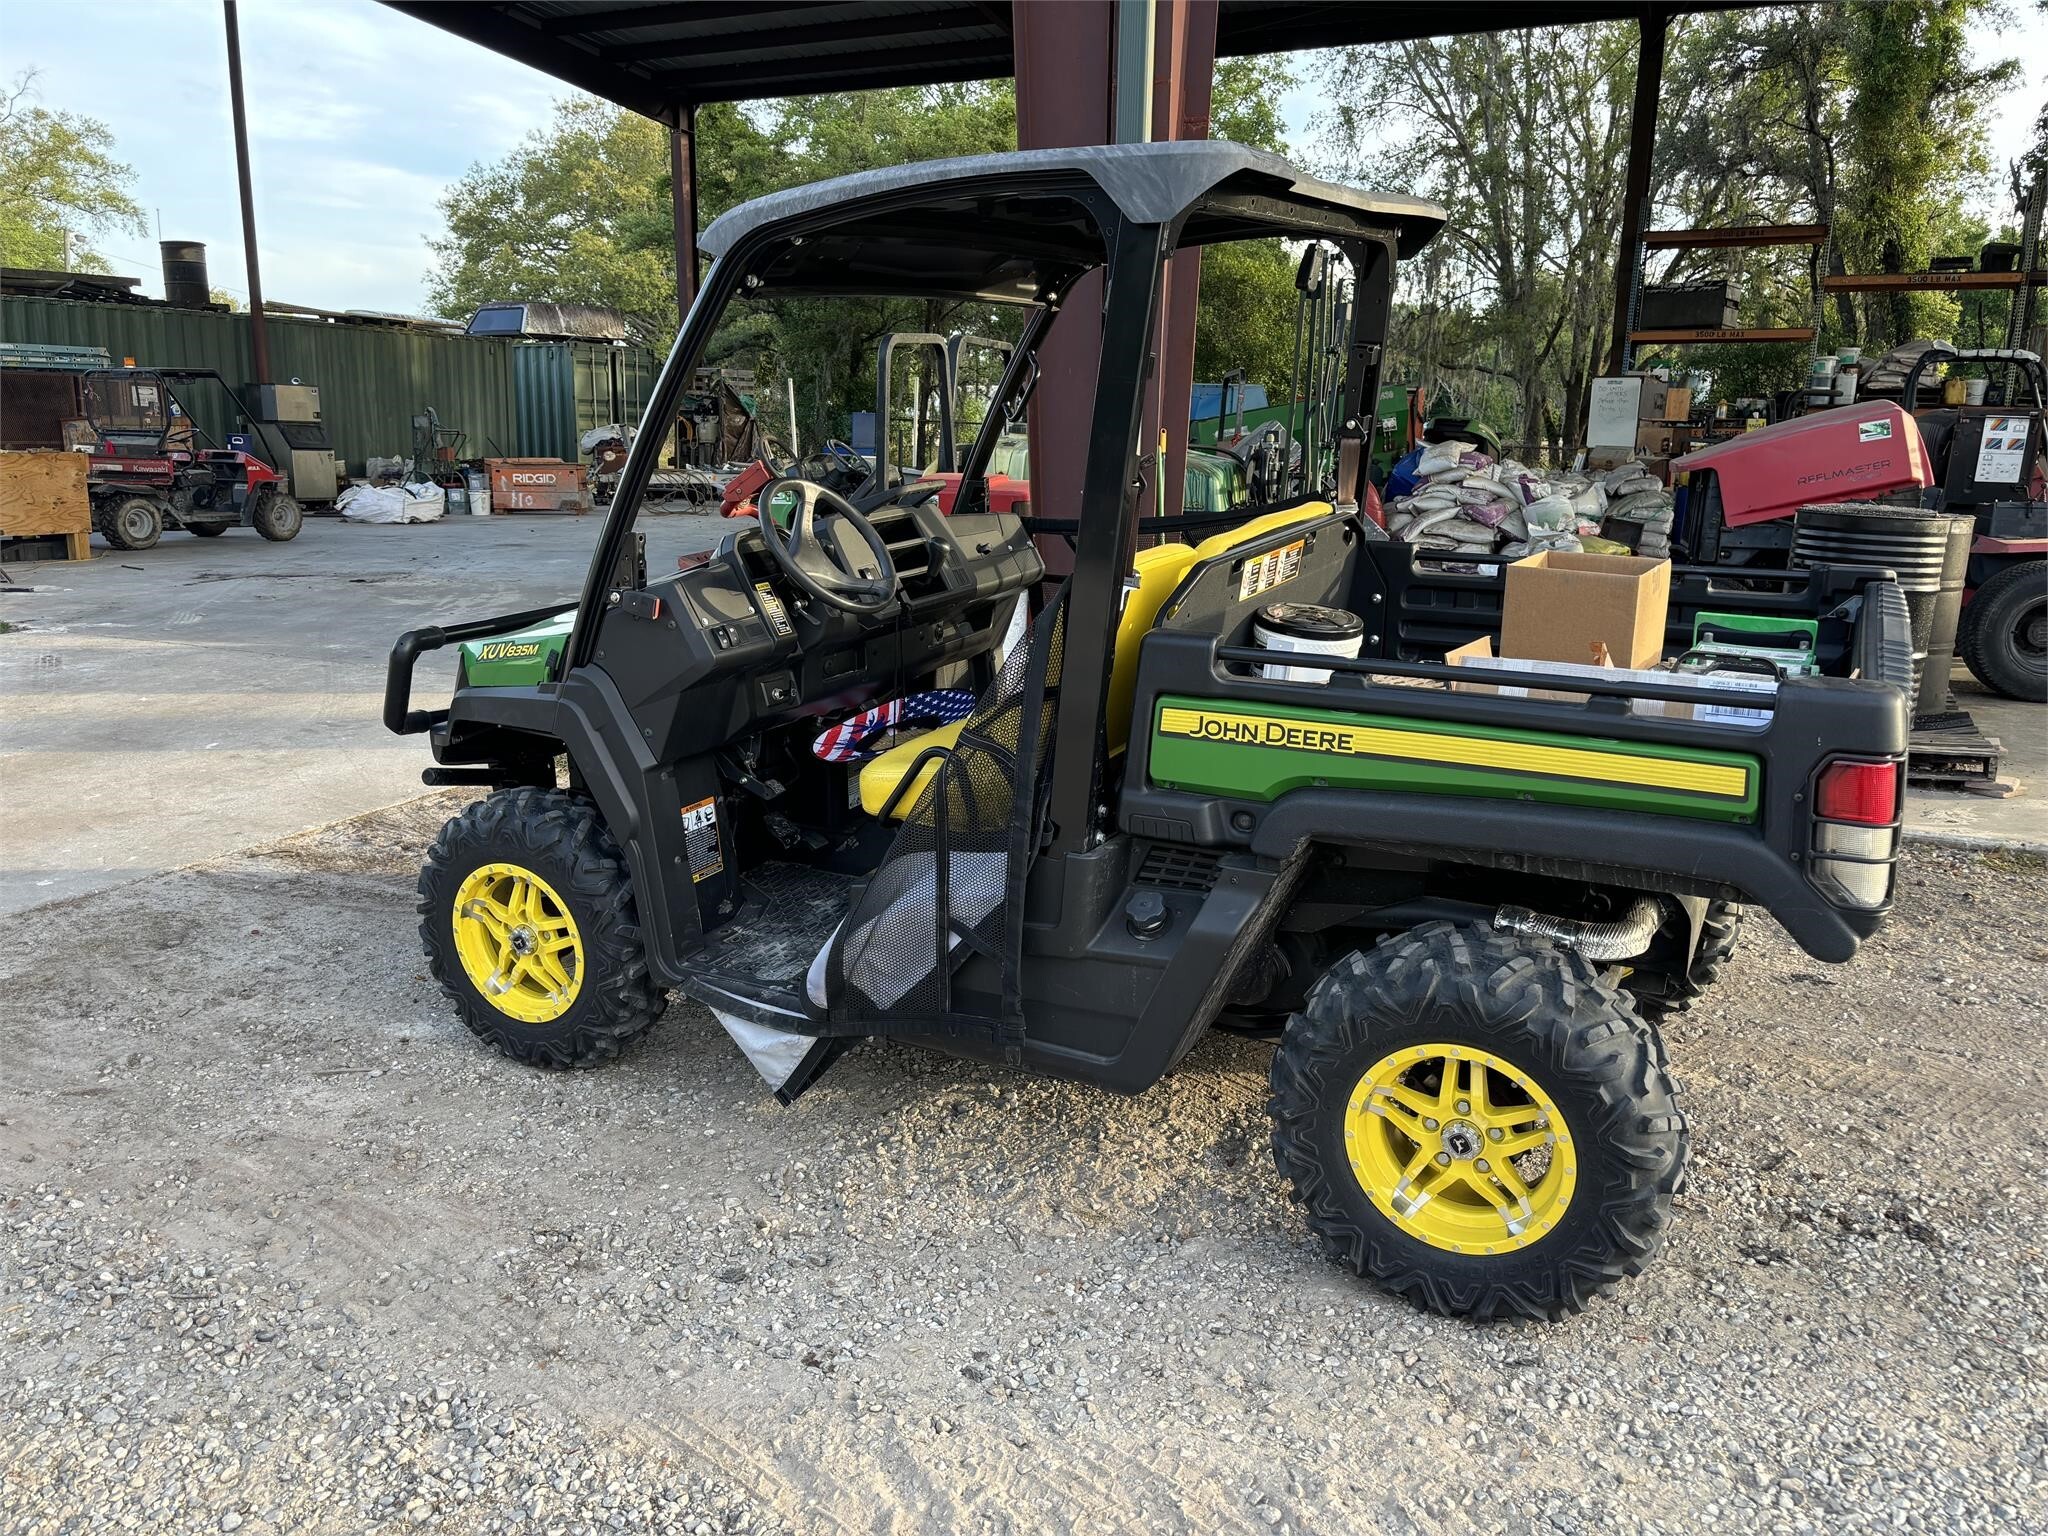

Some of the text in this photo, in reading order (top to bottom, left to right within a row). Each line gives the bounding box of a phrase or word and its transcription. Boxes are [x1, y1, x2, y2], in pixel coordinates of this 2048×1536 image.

[1944, 274, 1962, 282] MAX
[1730, 330, 1745, 338] MAX
[133, 464, 168, 473] Kawasaki
[512, 473, 556, 484] RIDGID
[1189, 715, 1353, 751] JOHN DEERE
